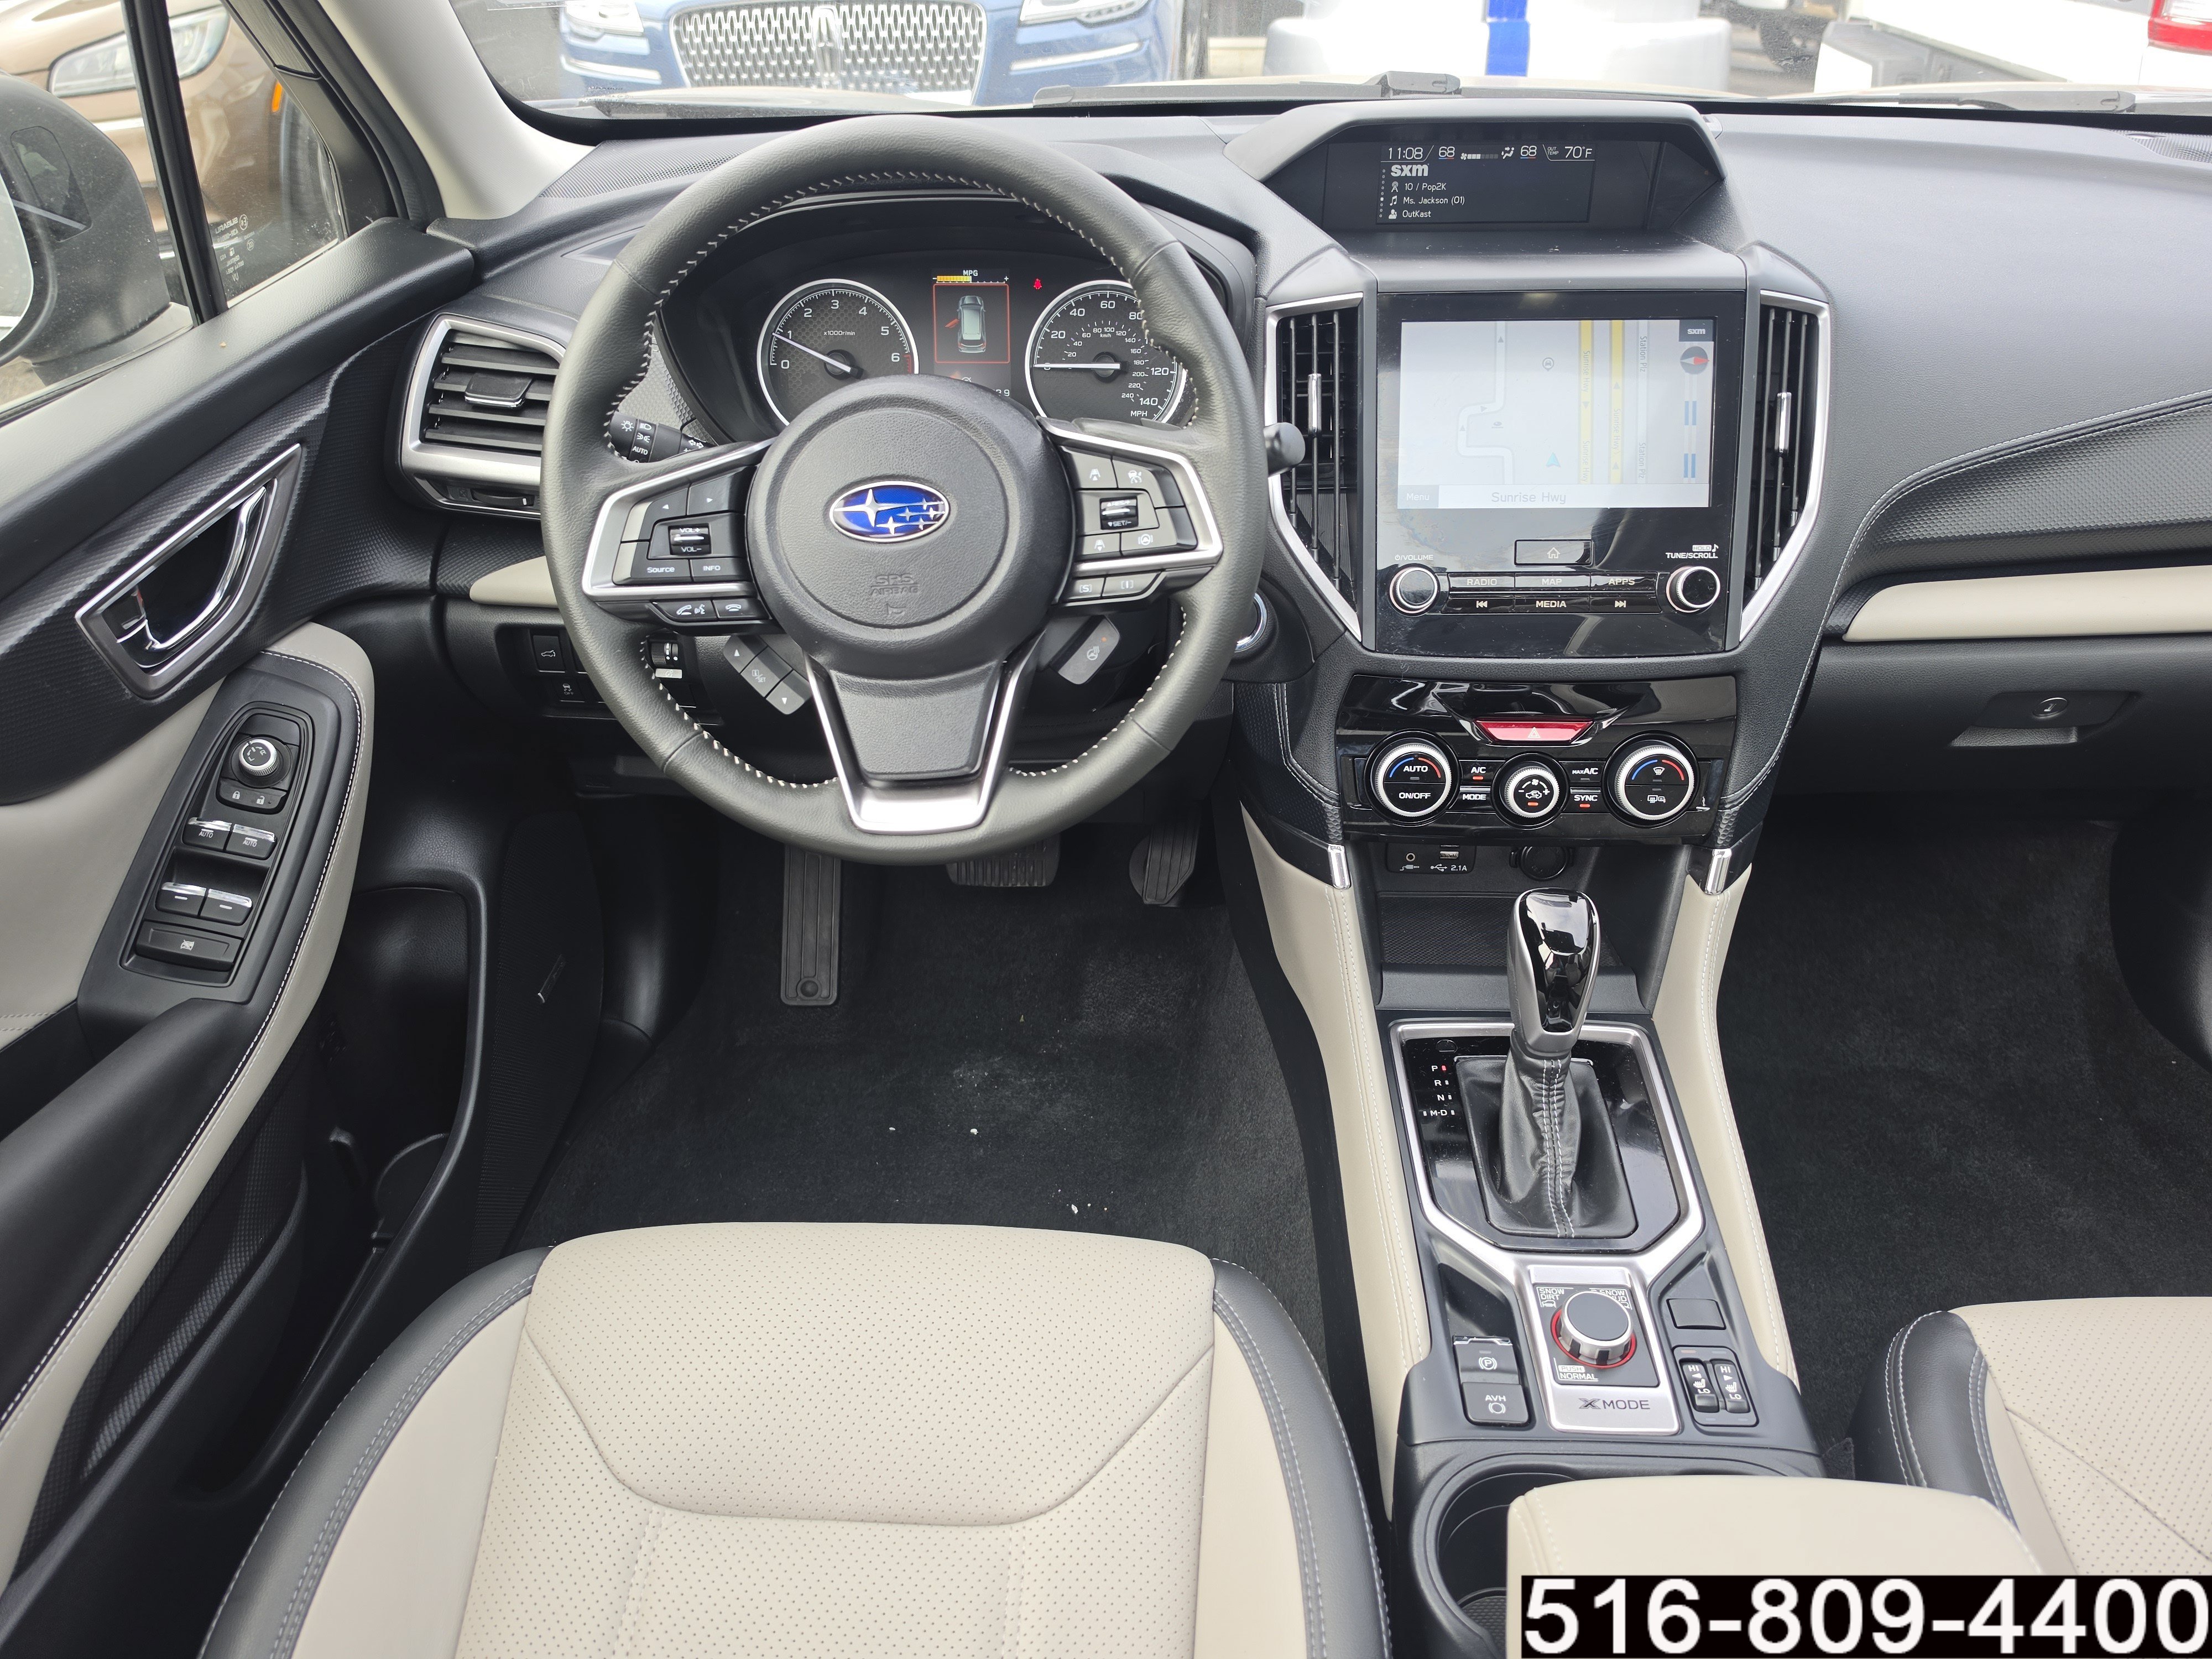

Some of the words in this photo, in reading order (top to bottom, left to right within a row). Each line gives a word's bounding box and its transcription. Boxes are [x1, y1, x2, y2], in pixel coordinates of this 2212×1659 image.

[1389, 147, 1423, 160] 11:08
[1438, 146, 1455, 158] 68
[1520, 145, 1537, 157] 68
[1390, 164, 1429, 177] sxm
[1416, 182, 1420, 191] /
[1422, 182, 1447, 192] Pop2K
[1403, 196, 1416, 205] Ms.
[1418, 196, 1448, 205] Jackson
[1451, 196, 1465, 206] (01)
[1402, 210, 1432, 218] OutKast
[831, 300, 839, 309] 3
[1100, 300, 1115, 309] 60
[804, 308, 812, 317] 2
[858, 306, 868, 316] 4
[1070, 308, 1086, 317] 40
[1129, 312, 1143, 320] 80
[787, 331, 792, 339] 1
[880, 326, 889, 336] 5
[1051, 331, 1066, 339] 20
[1639, 336, 1647, 360] Station
[891, 353, 900, 362] 6
[781, 359, 790, 369] 0
[1639, 362, 1647, 372] Plz
[1150, 367, 1169, 375] 120
[1139, 398, 1159, 406] 140
[632, 446, 648, 456] AUTO
[1580, 467, 1590, 482] Hwy
[1406, 493, 1430, 501] Menu
[1491, 492, 1536, 503] Sunrise
[1542, 492, 1566, 504] Hwy
[875, 573, 915, 586] SRS
[199, 830, 214, 838] AUTO
[1559, 1372, 1599, 1380] NORMAL
[1603, 1400, 1651, 1410] MODE
